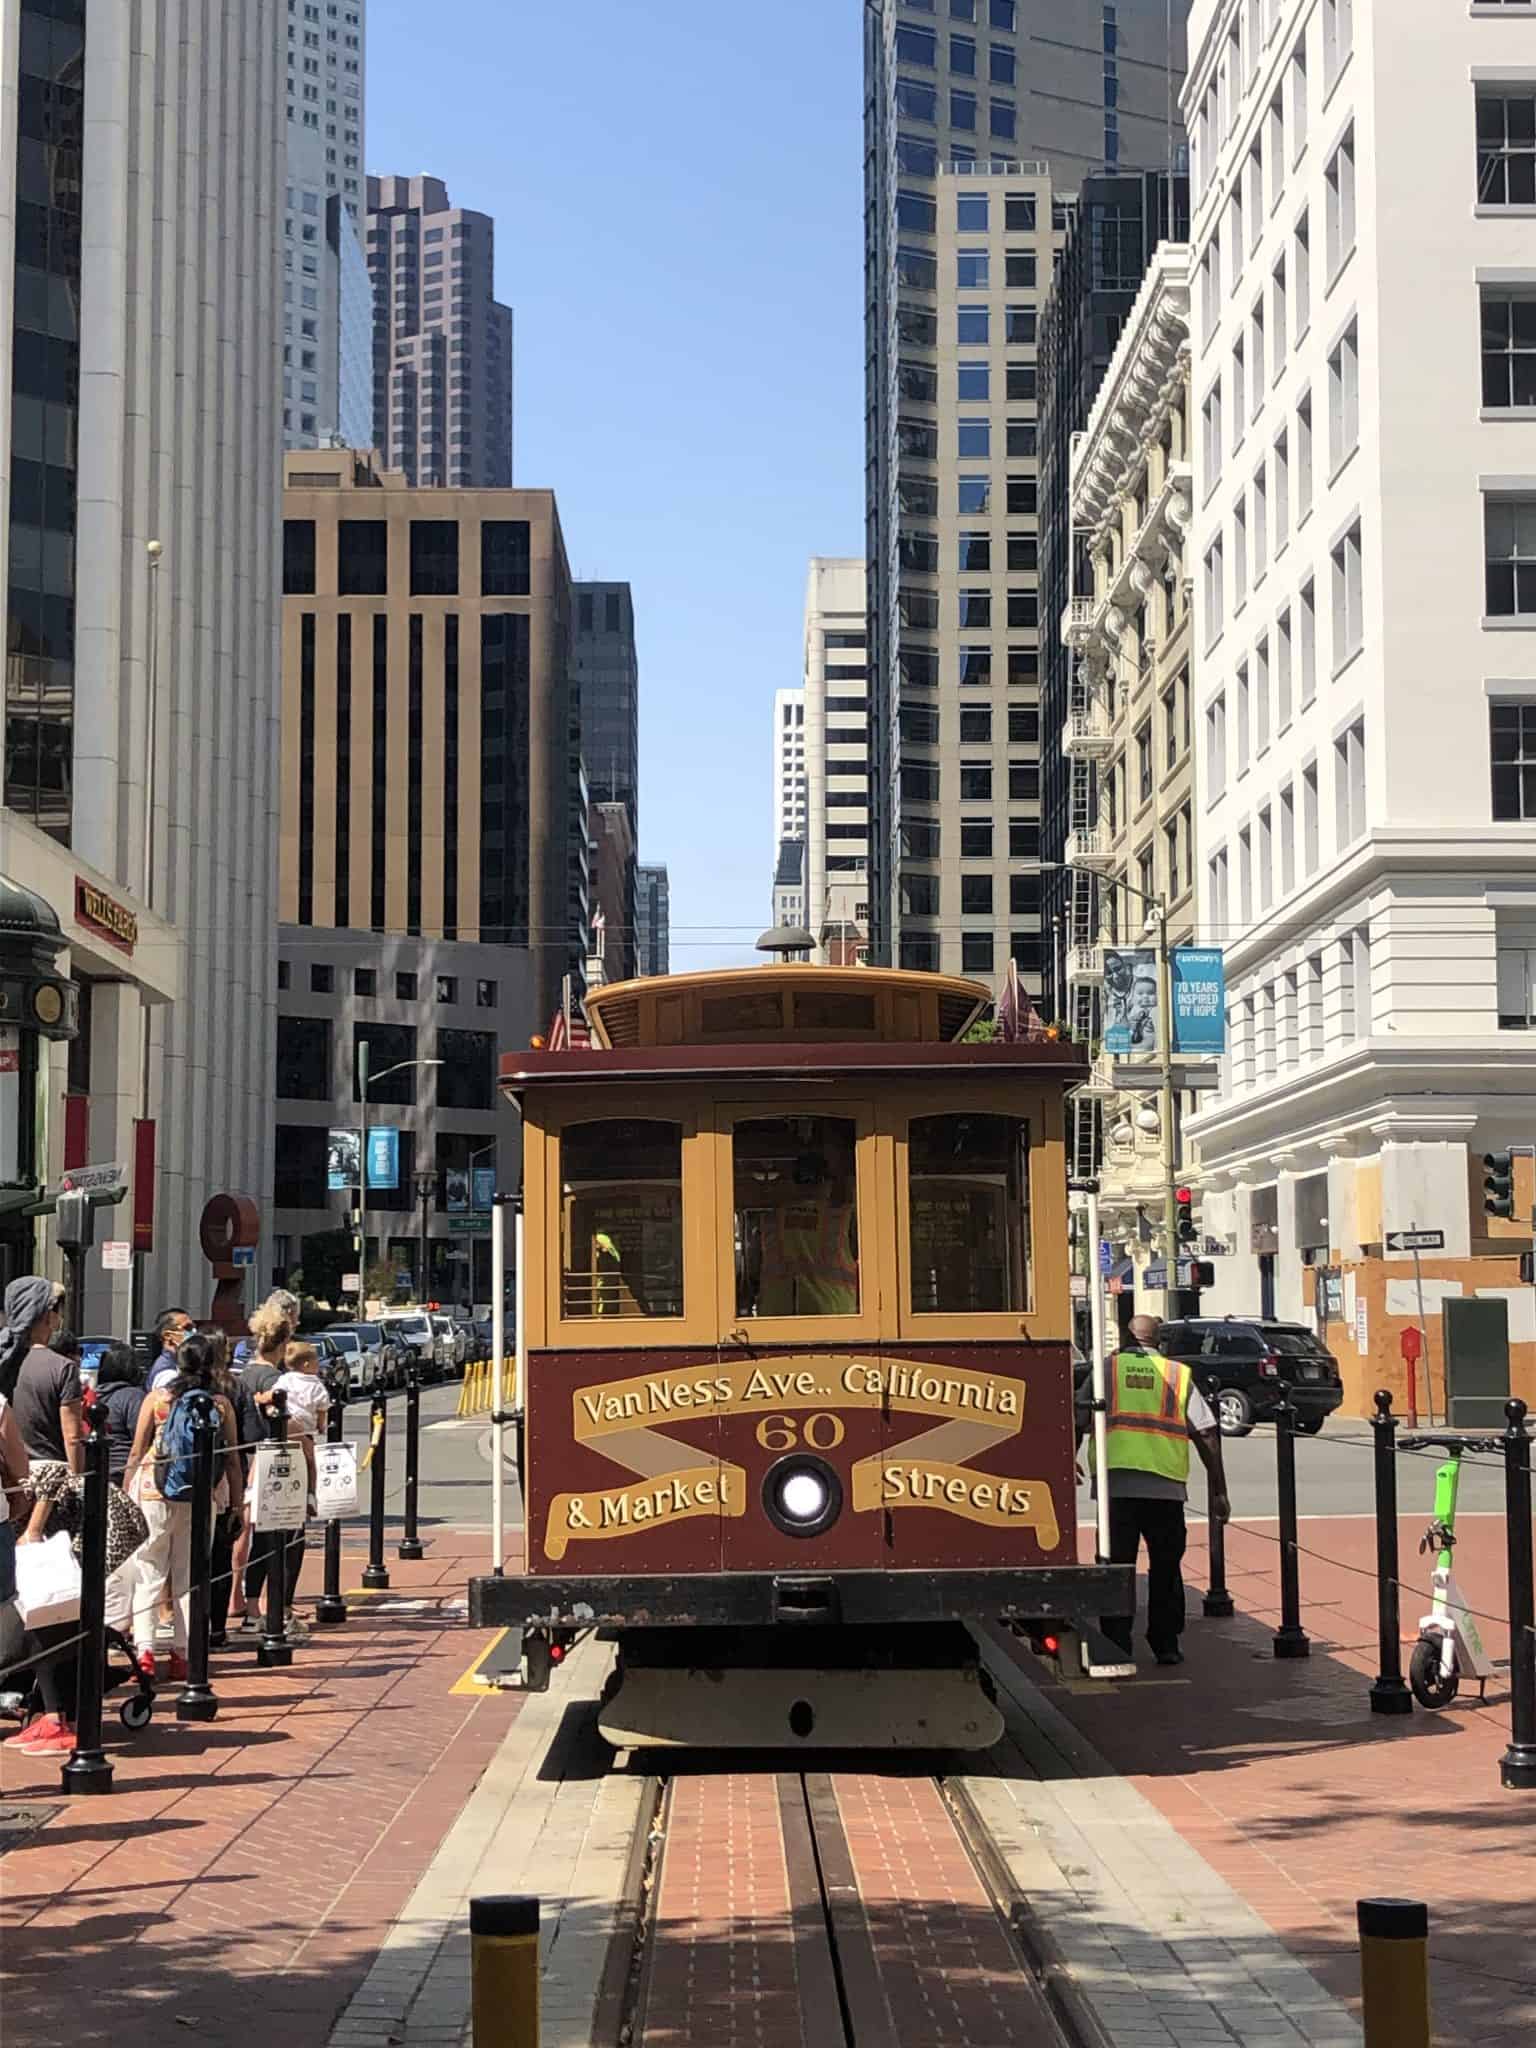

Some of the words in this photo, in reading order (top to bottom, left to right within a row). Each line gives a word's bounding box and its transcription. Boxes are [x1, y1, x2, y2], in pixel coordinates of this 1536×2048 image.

[1178, 993, 1218, 1004] INSPIRED
[1190, 982, 1218, 992] YEARS
[1194, 1005, 1217, 1016] HOPE
[583, 1391, 643, 1424] Van
[646, 1377, 733, 1412] Ness
[842, 1363, 1018, 1415] California
[755, 1413, 846, 1450] 60
[567, 1497, 593, 1529] &
[600, 1473, 729, 1528] Market
[883, 1466, 1032, 1515] Streets
